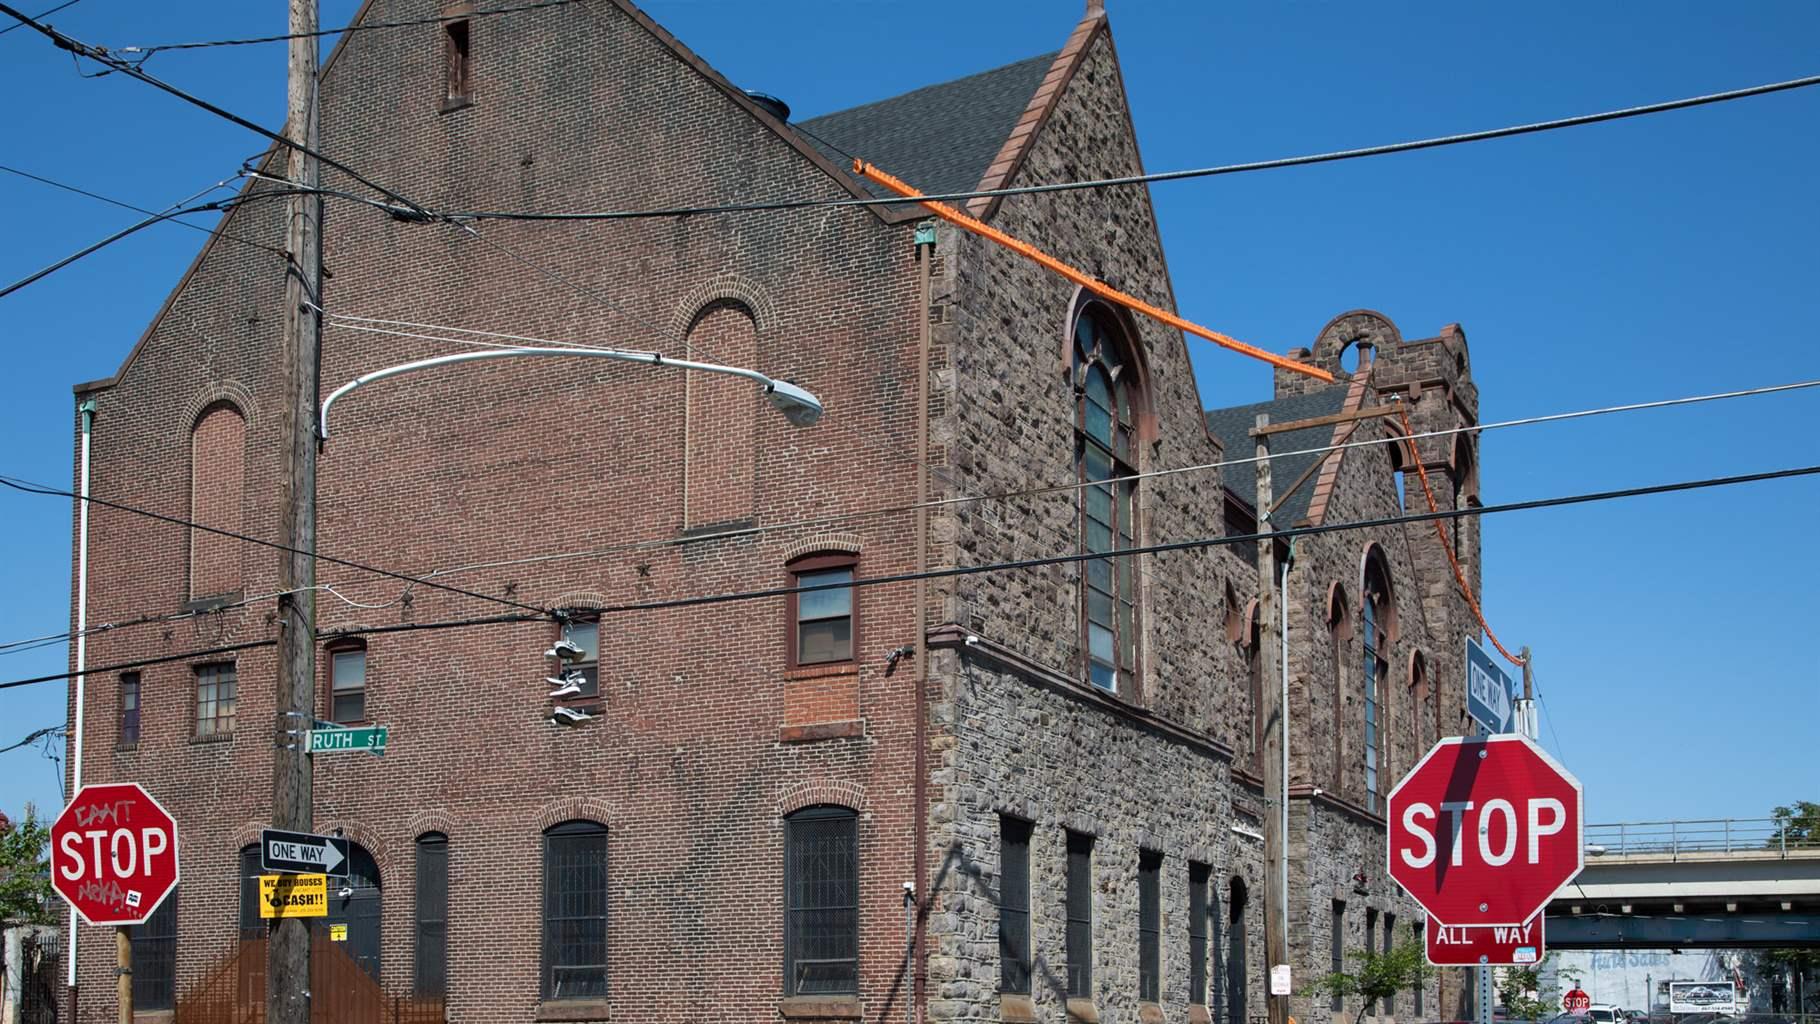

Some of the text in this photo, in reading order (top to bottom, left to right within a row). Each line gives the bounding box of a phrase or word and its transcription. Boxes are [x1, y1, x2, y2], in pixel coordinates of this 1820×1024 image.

[1472, 665, 1501, 716] ONE WAY
[312, 732, 382, 749] RUTH ST
[1400, 797, 1567, 869] STOP
[60, 827, 167, 881] STOP
[272, 842, 325, 863] ONE WAY
[263, 878, 323, 888] WE BUY HOUSES
[1435, 923, 1533, 945] ALL WAY
[1565, 997, 1589, 1008] STOP
